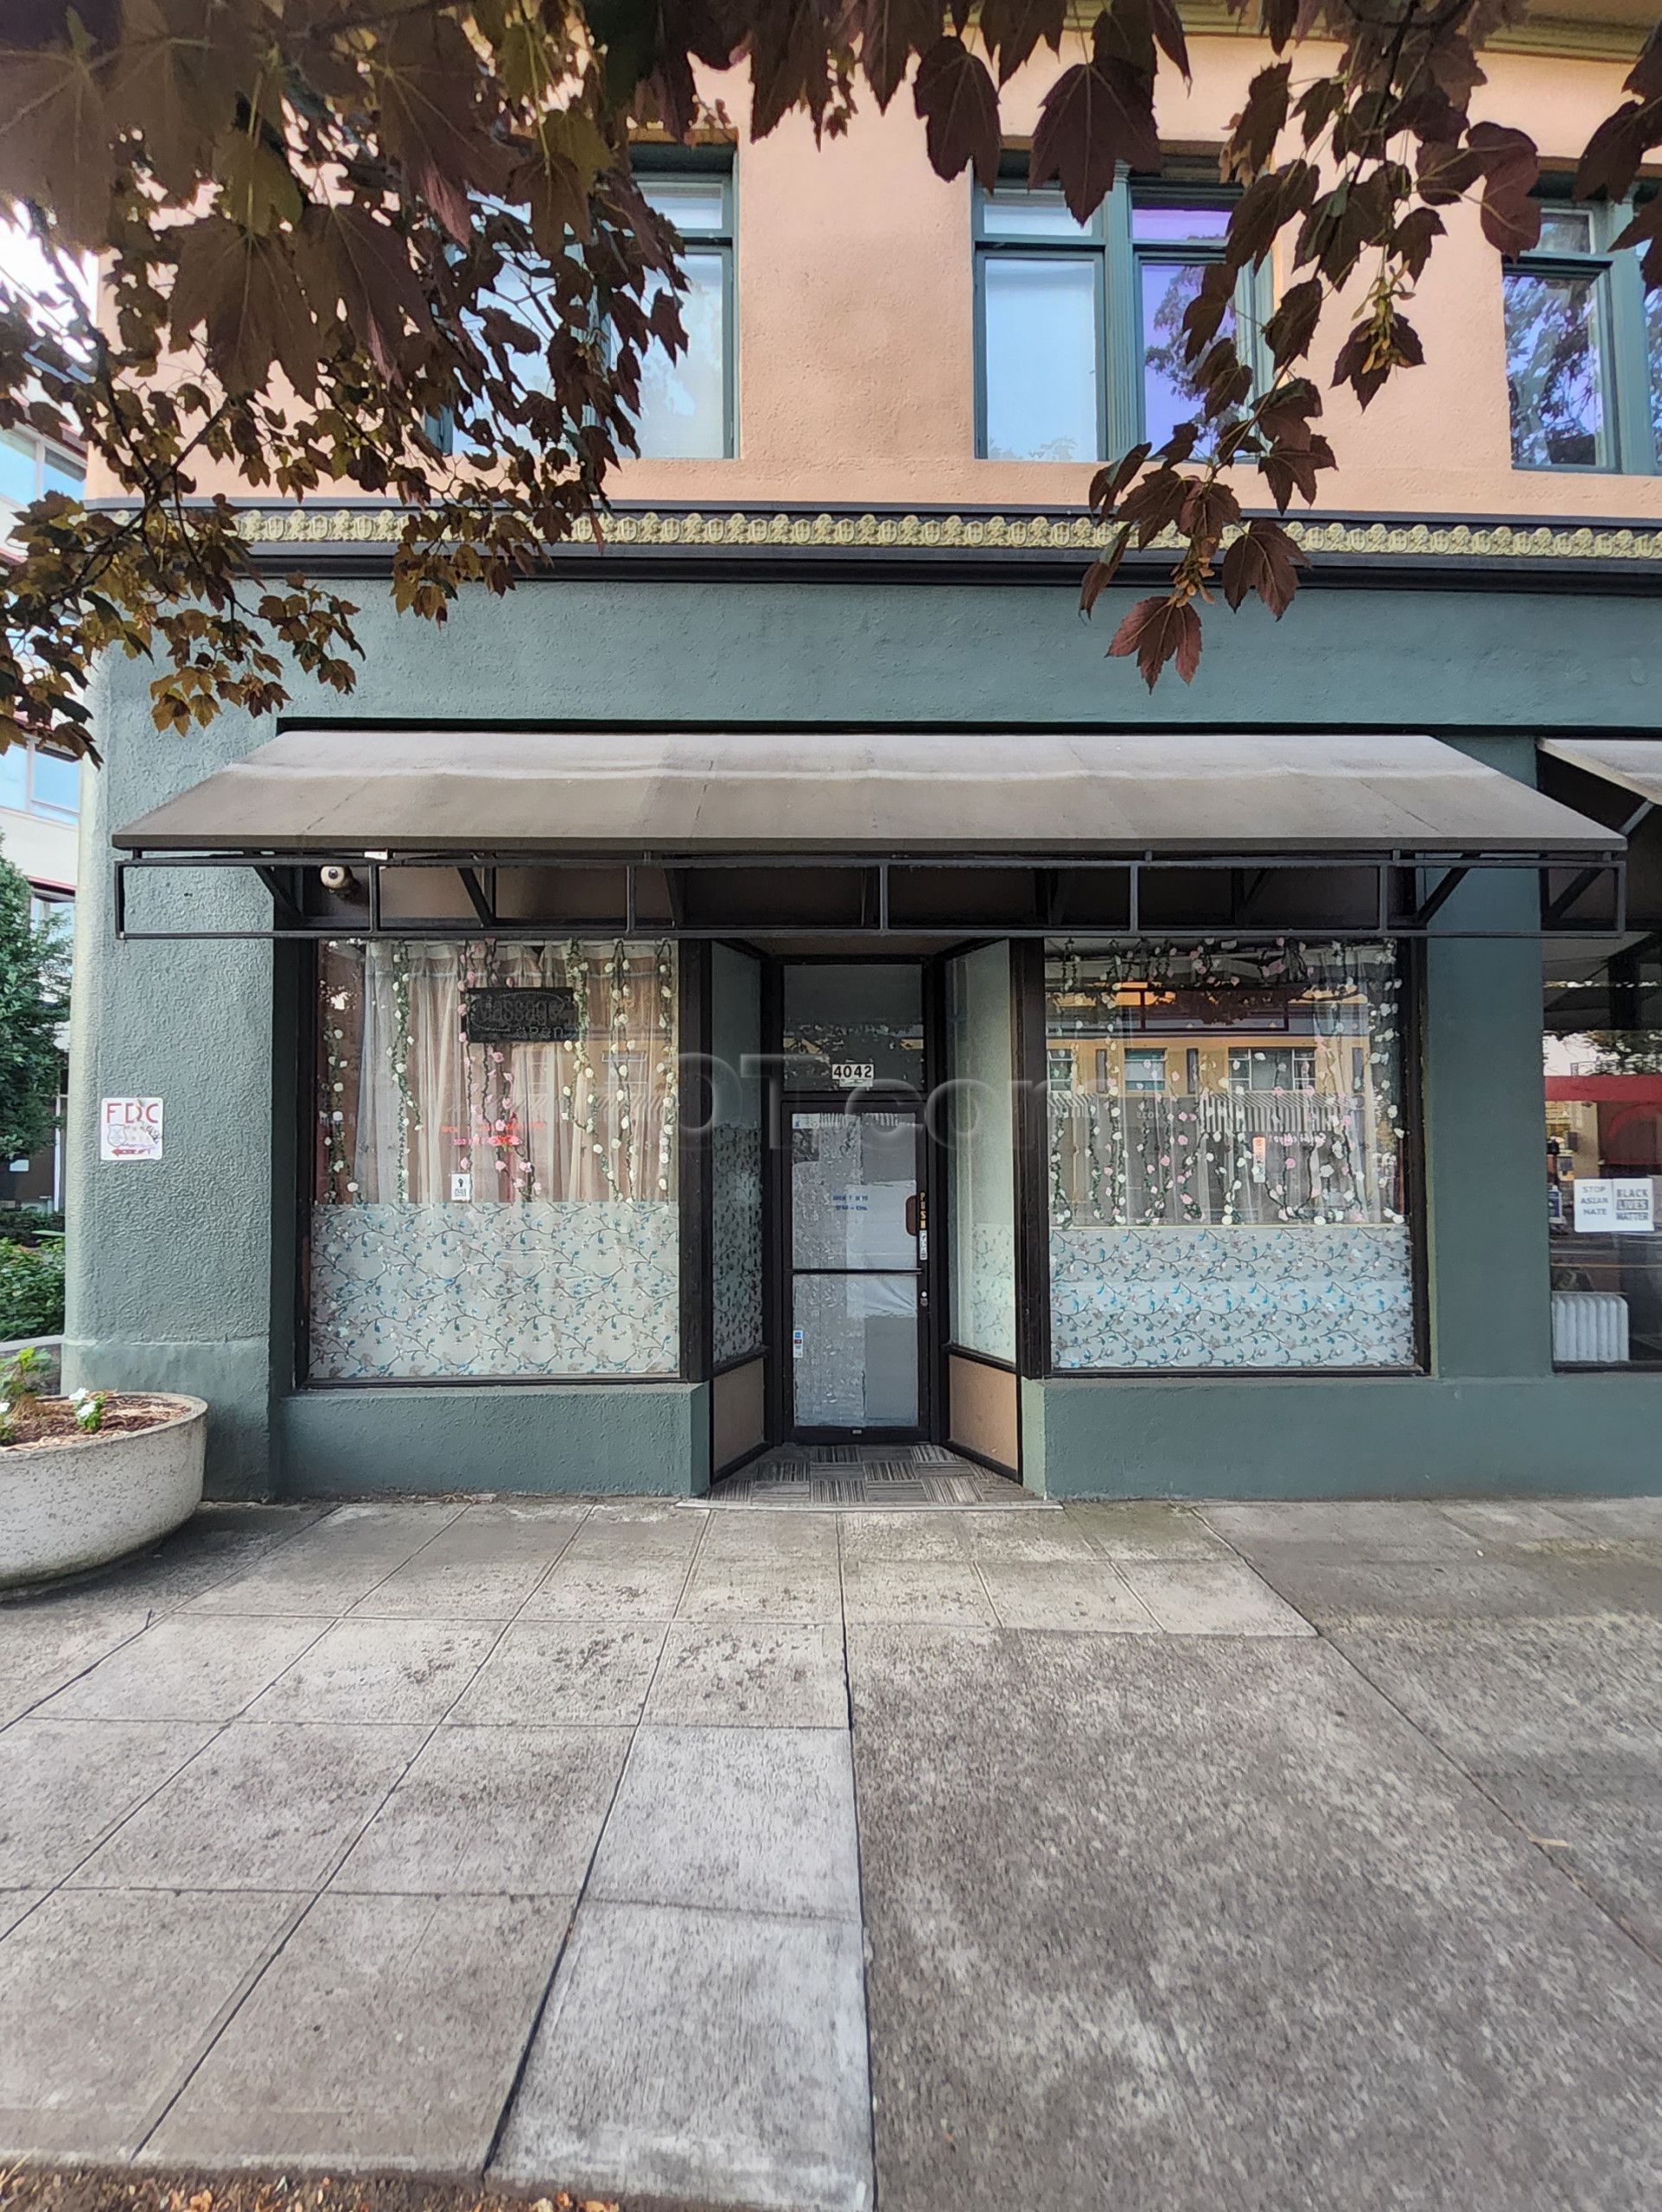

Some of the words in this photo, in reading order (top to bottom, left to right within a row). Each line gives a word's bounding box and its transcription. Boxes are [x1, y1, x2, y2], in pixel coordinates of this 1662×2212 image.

[833, 1065, 872, 1078] 4042
[107, 1103, 159, 1123] FDC
[1617, 1189, 1649, 1198] BLACK
[1618, 1199, 1647, 1211] LIVES
[1616, 1211, 1649, 1221] MATTER
